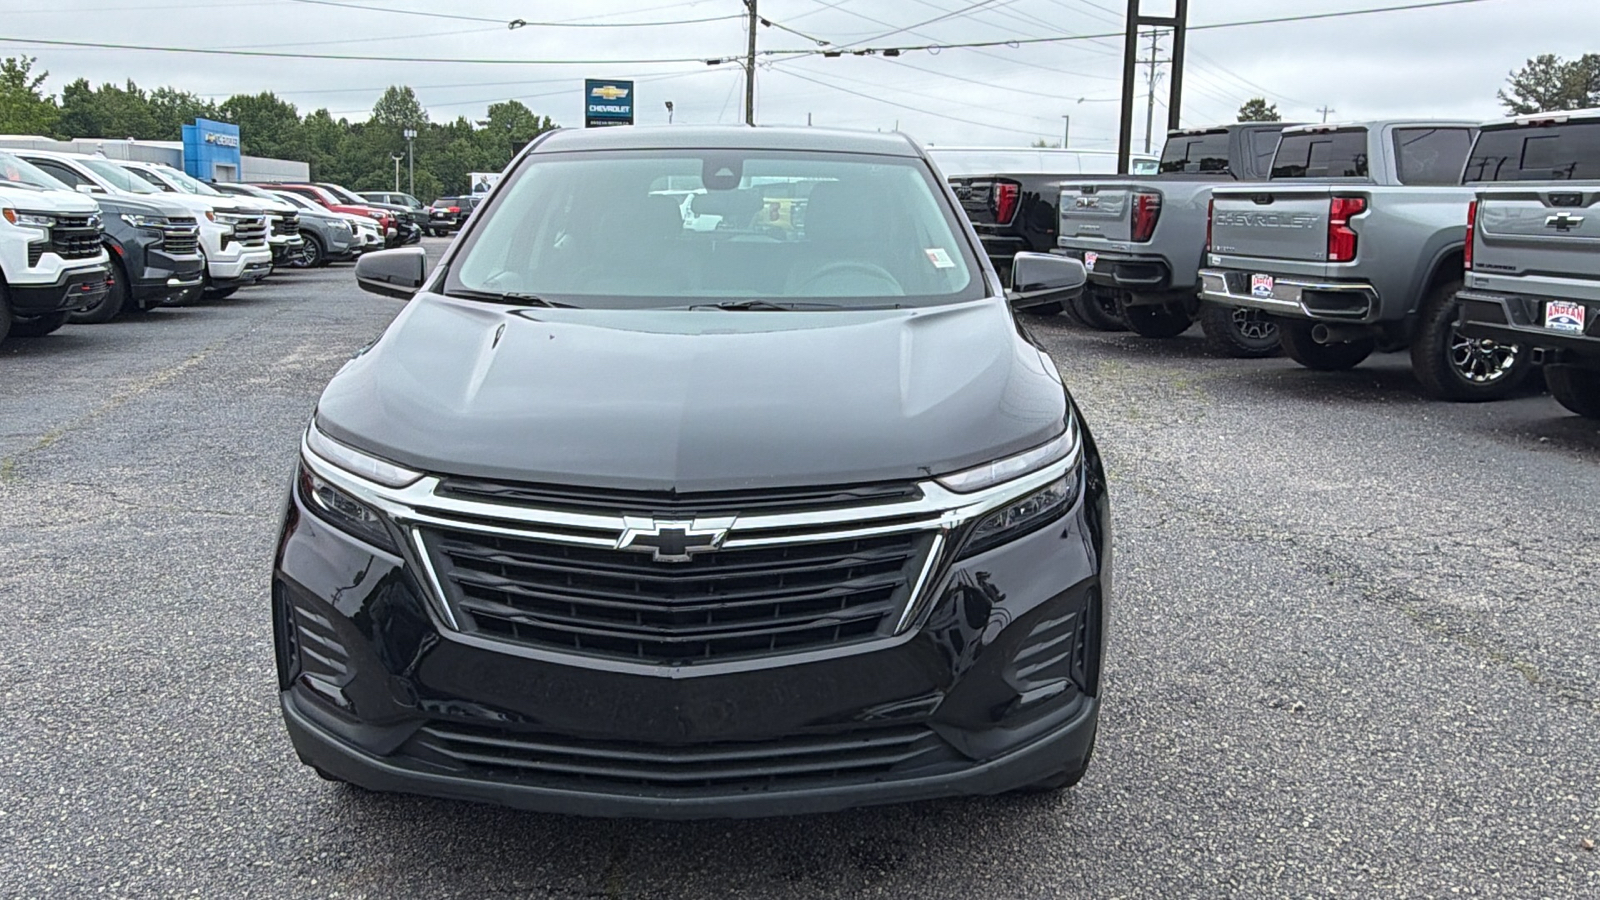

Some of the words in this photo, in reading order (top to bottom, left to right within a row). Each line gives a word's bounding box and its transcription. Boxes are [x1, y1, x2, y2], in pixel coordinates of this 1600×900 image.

[589, 105, 630, 113] CHEVROLET
[1216, 212, 1320, 229] CHEVROLET
[1548, 305, 1584, 323] ANDEAN
